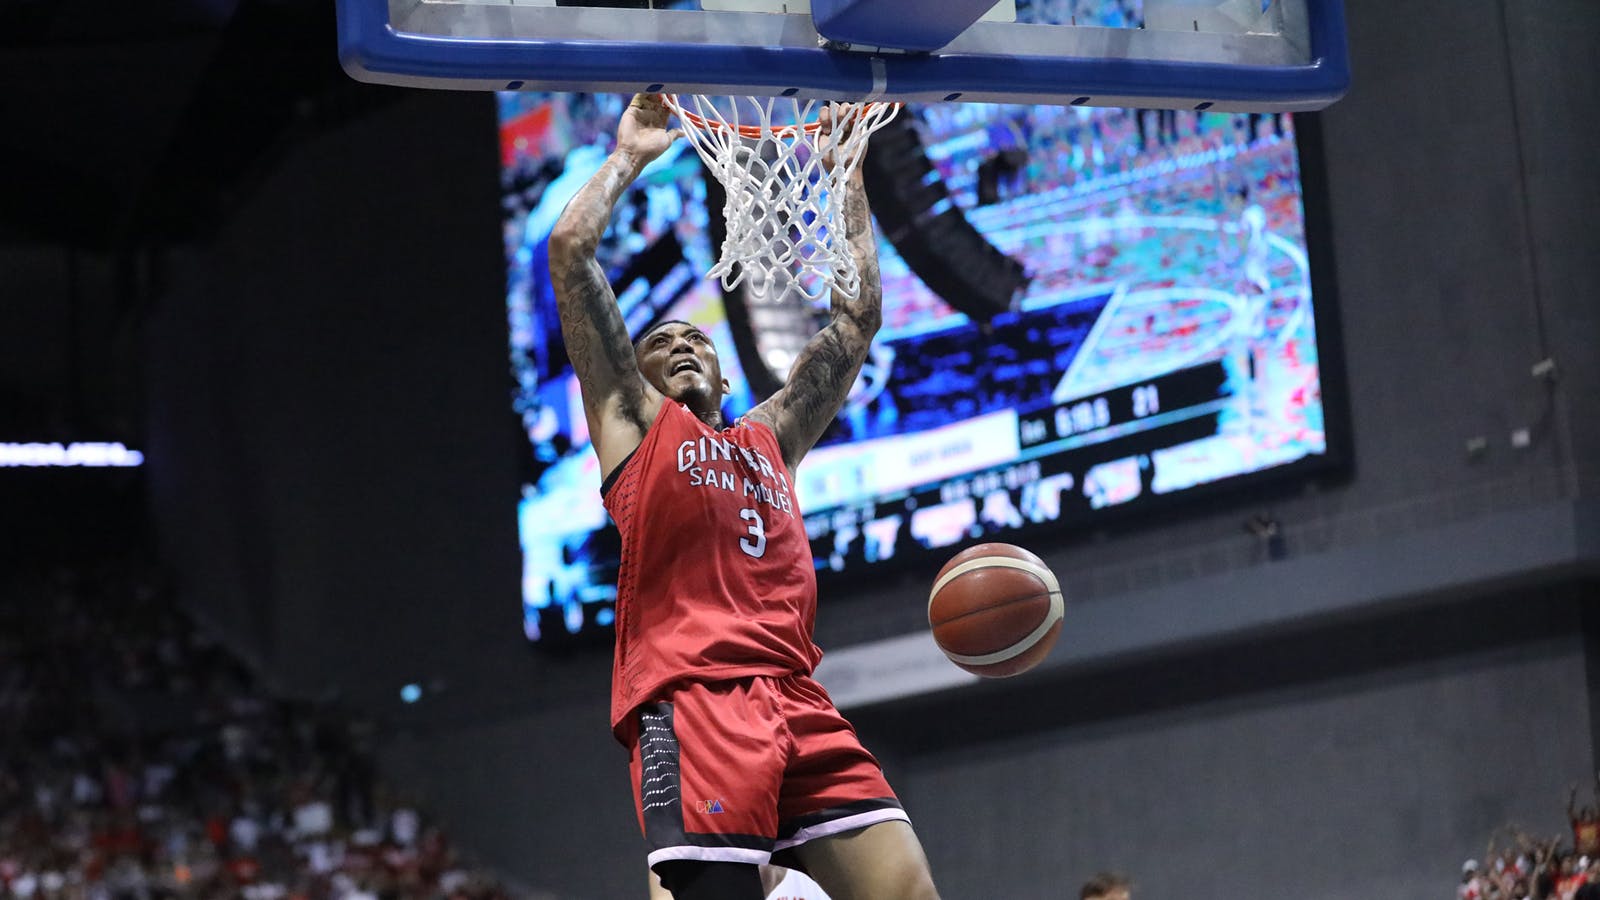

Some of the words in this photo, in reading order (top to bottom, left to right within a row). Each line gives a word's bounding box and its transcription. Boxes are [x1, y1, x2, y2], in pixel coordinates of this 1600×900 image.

[677, 436, 789, 494] GINBRA
[689, 466, 735, 492] SAN
[739, 508, 766, 558] 3
